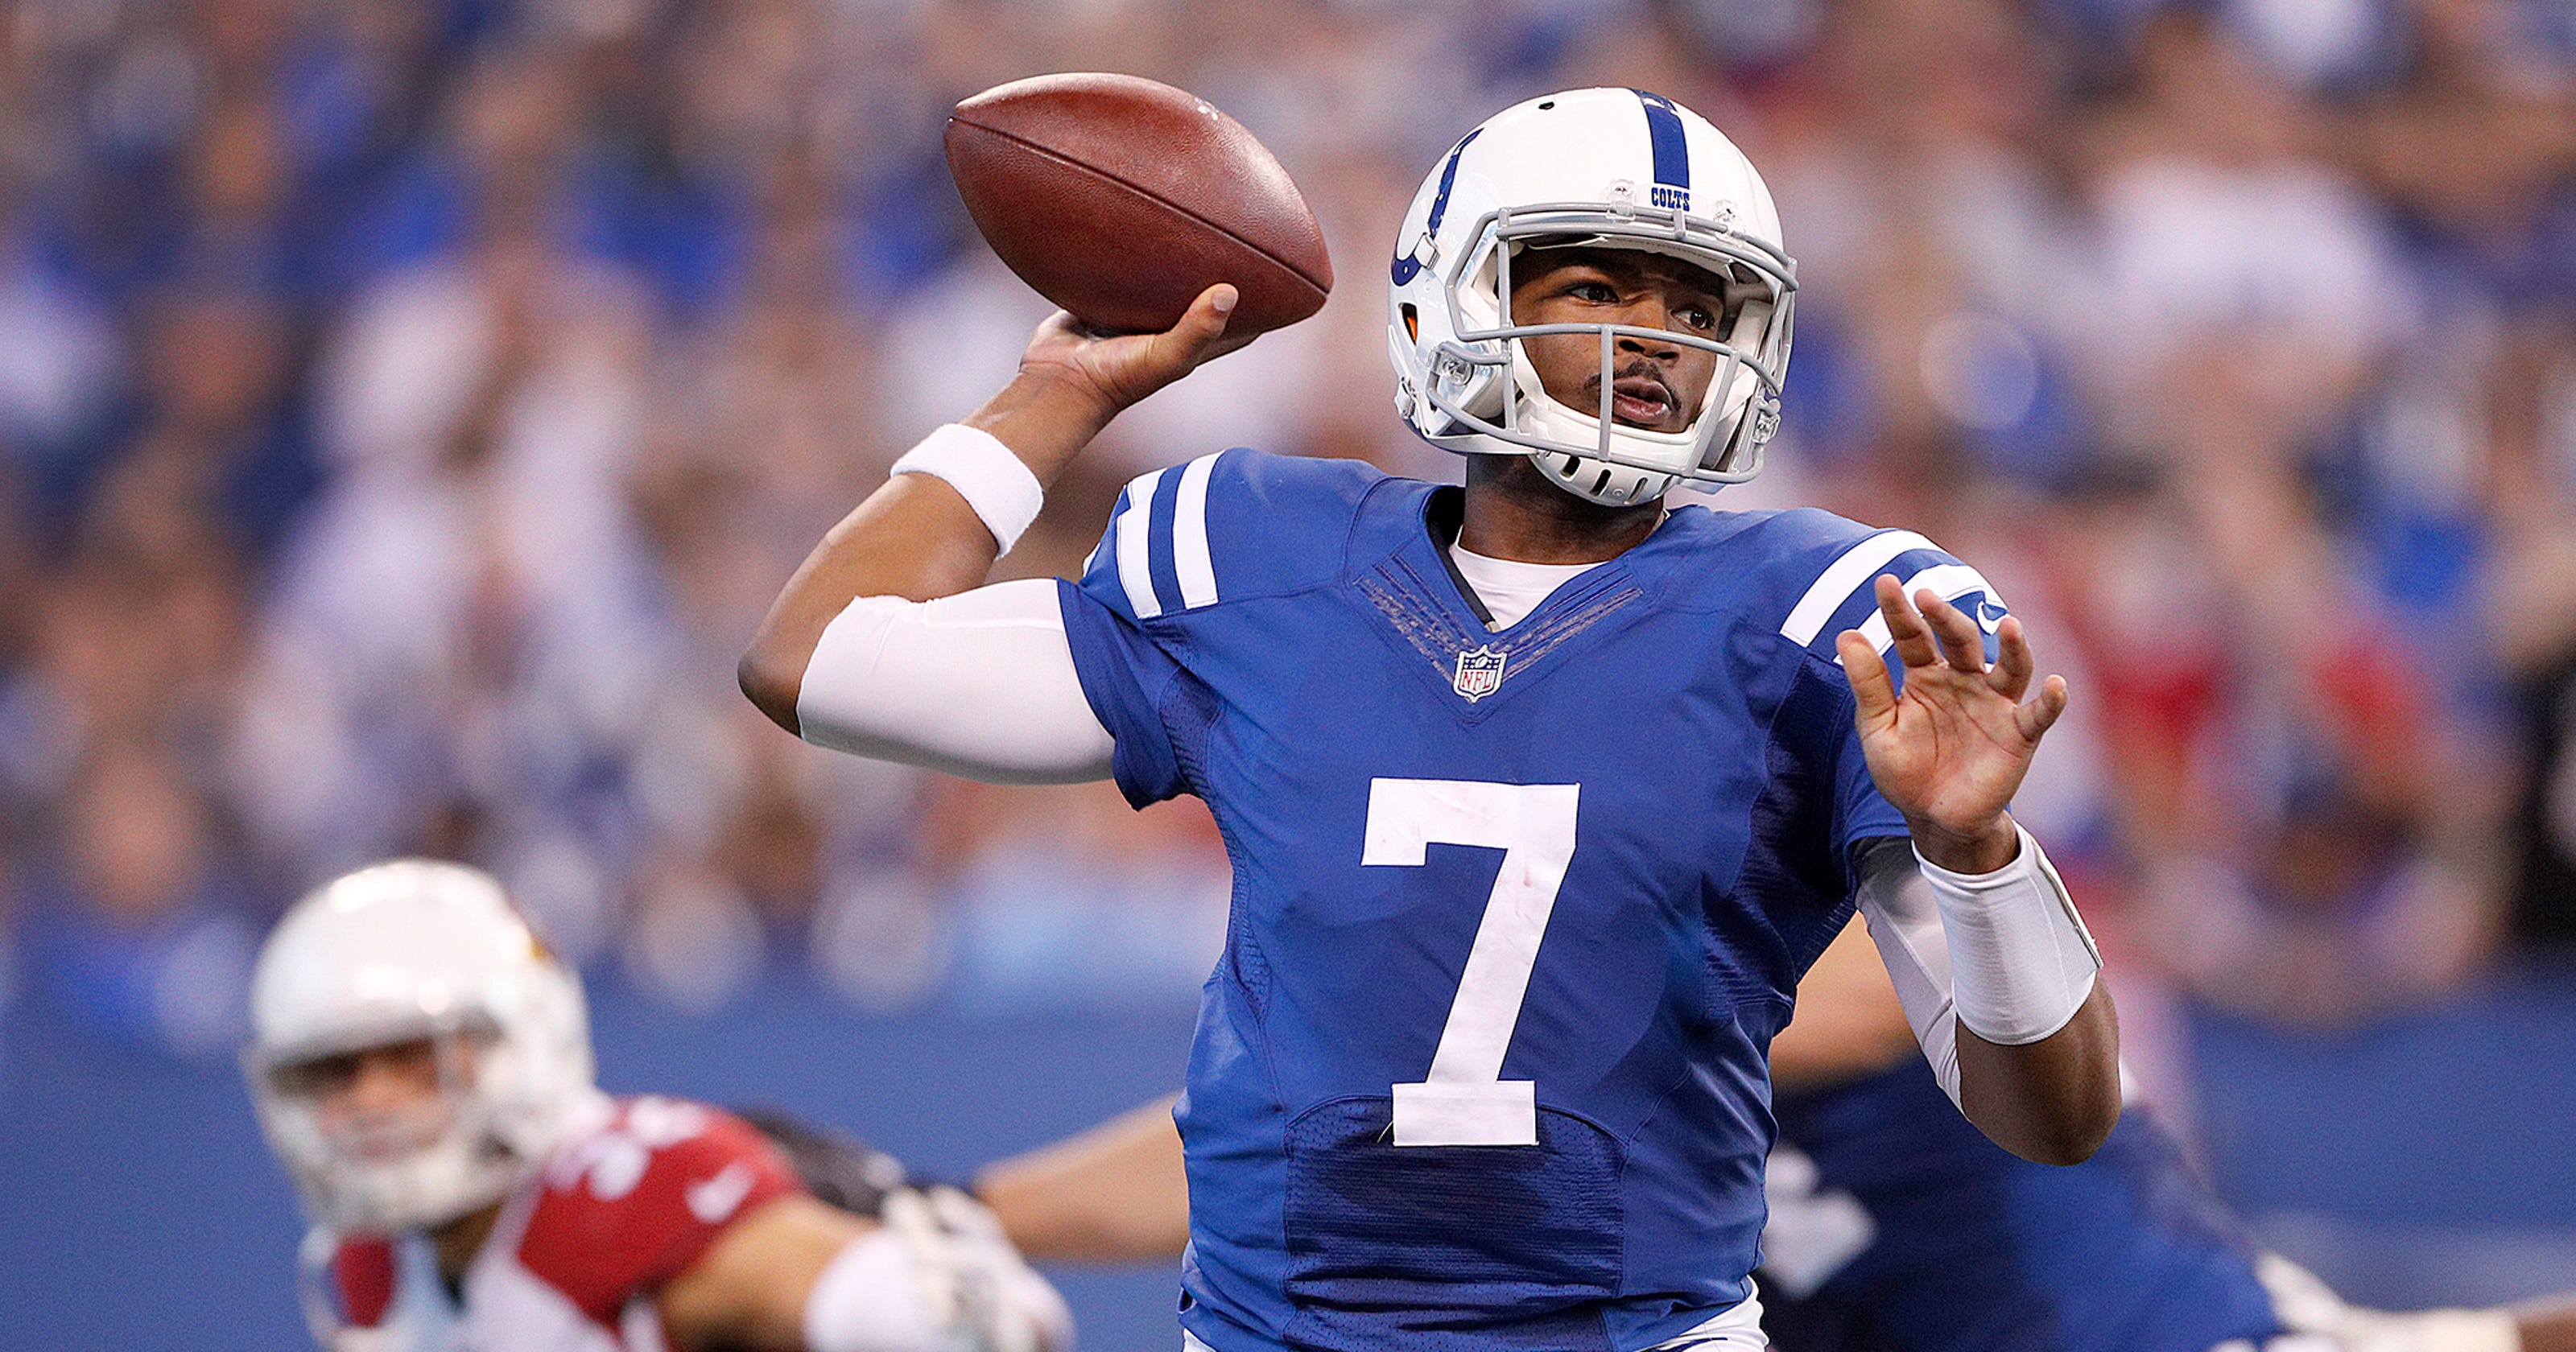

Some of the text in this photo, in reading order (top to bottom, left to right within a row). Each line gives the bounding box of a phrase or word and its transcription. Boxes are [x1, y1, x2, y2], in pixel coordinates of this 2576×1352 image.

[1651, 187, 1690, 212] COLTS
[1461, 671, 1492, 690] NFL
[1361, 777, 1580, 1147] 7
